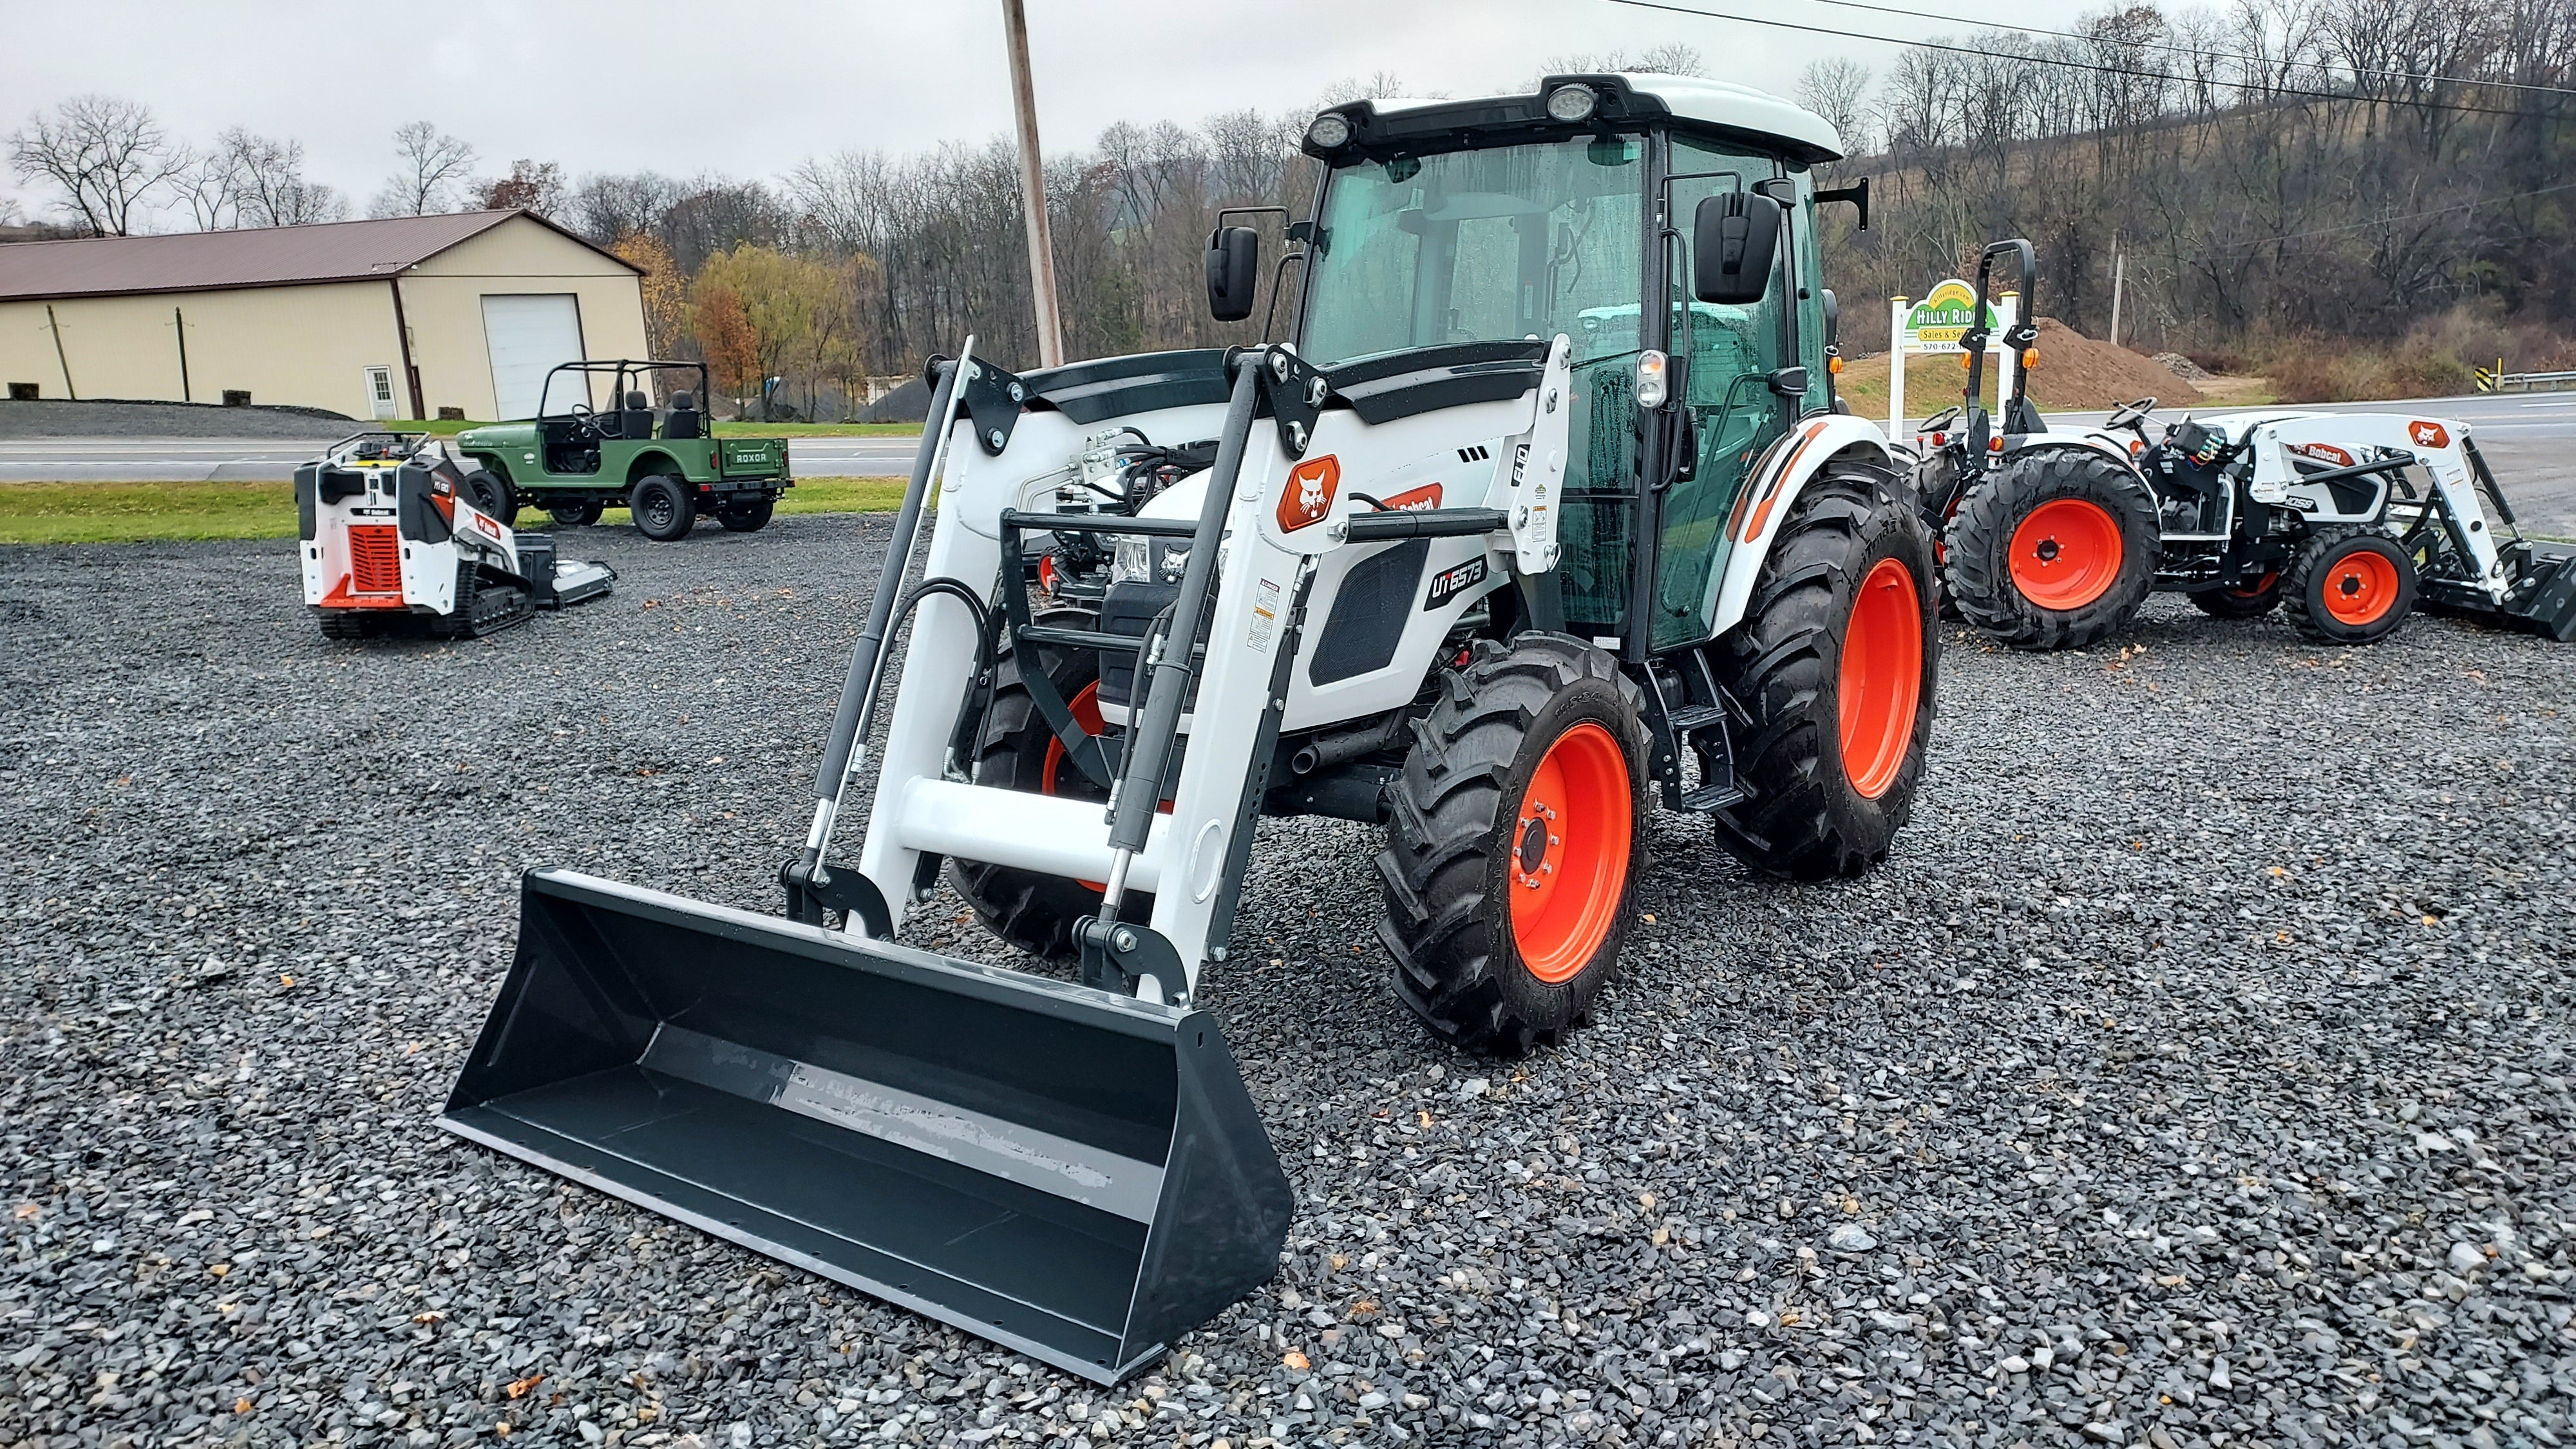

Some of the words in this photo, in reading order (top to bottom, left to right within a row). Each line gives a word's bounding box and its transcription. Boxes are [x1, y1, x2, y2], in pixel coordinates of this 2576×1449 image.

[1917, 309, 1947, 324] HILLY
[1924, 330, 1942, 339] Sales
[737, 453, 766, 463] ROXOR
[2308, 446, 2341, 463] Bobcat
[1432, 560, 1482, 598] UT6573
